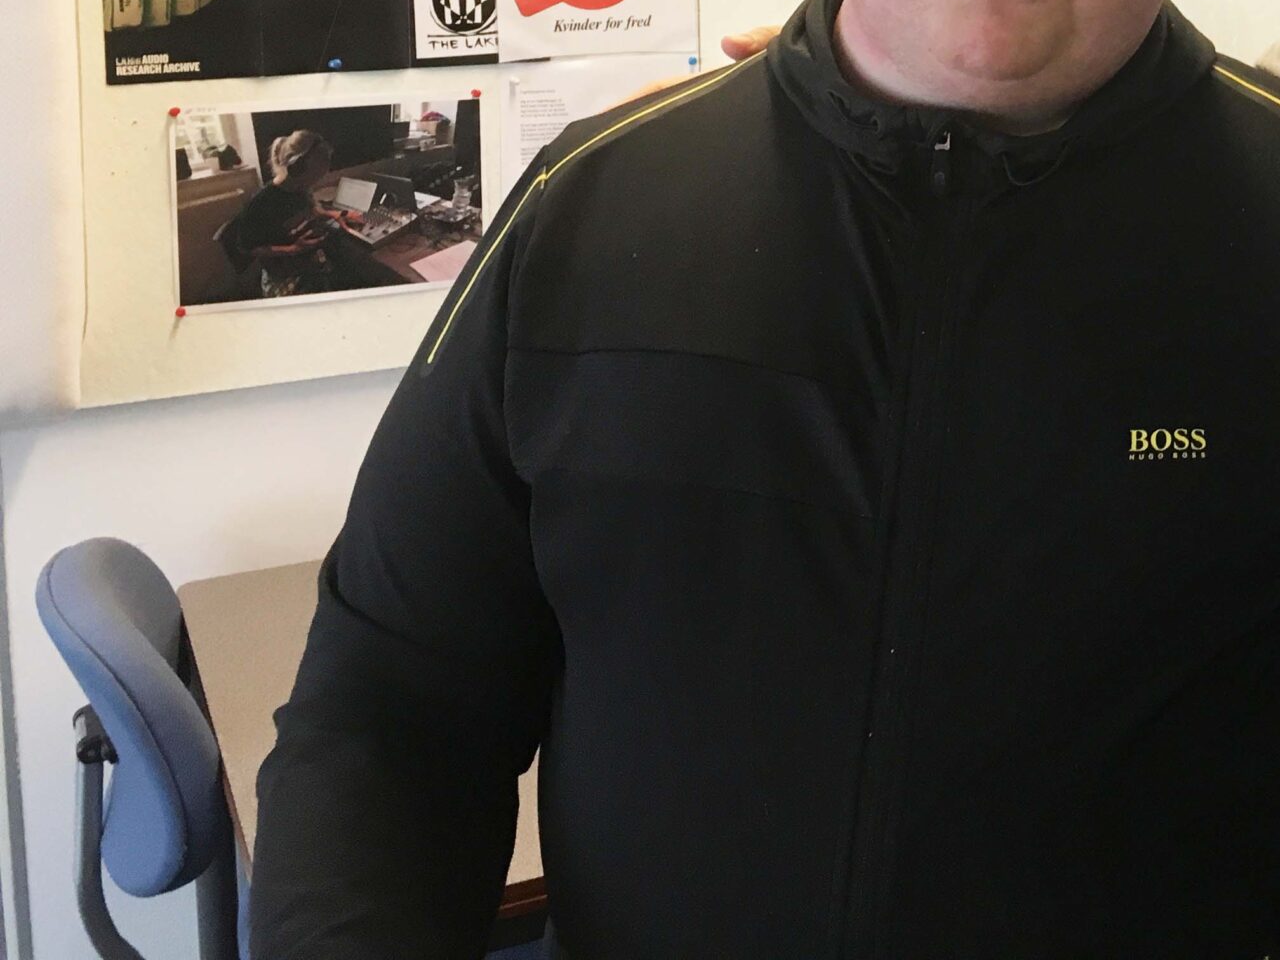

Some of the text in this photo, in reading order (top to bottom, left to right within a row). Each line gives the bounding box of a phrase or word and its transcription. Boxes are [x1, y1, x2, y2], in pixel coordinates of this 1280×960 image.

[554, 14, 652, 33] Kvinder for fred
[428, 40, 458, 51] THE
[142, 53, 169, 65] AUDIO
[116, 61, 200, 77] RESEARCH ARCHIVE
[1128, 428, 1207, 452] BOSS
[1128, 451, 1206, 461] HUGO BOSS
